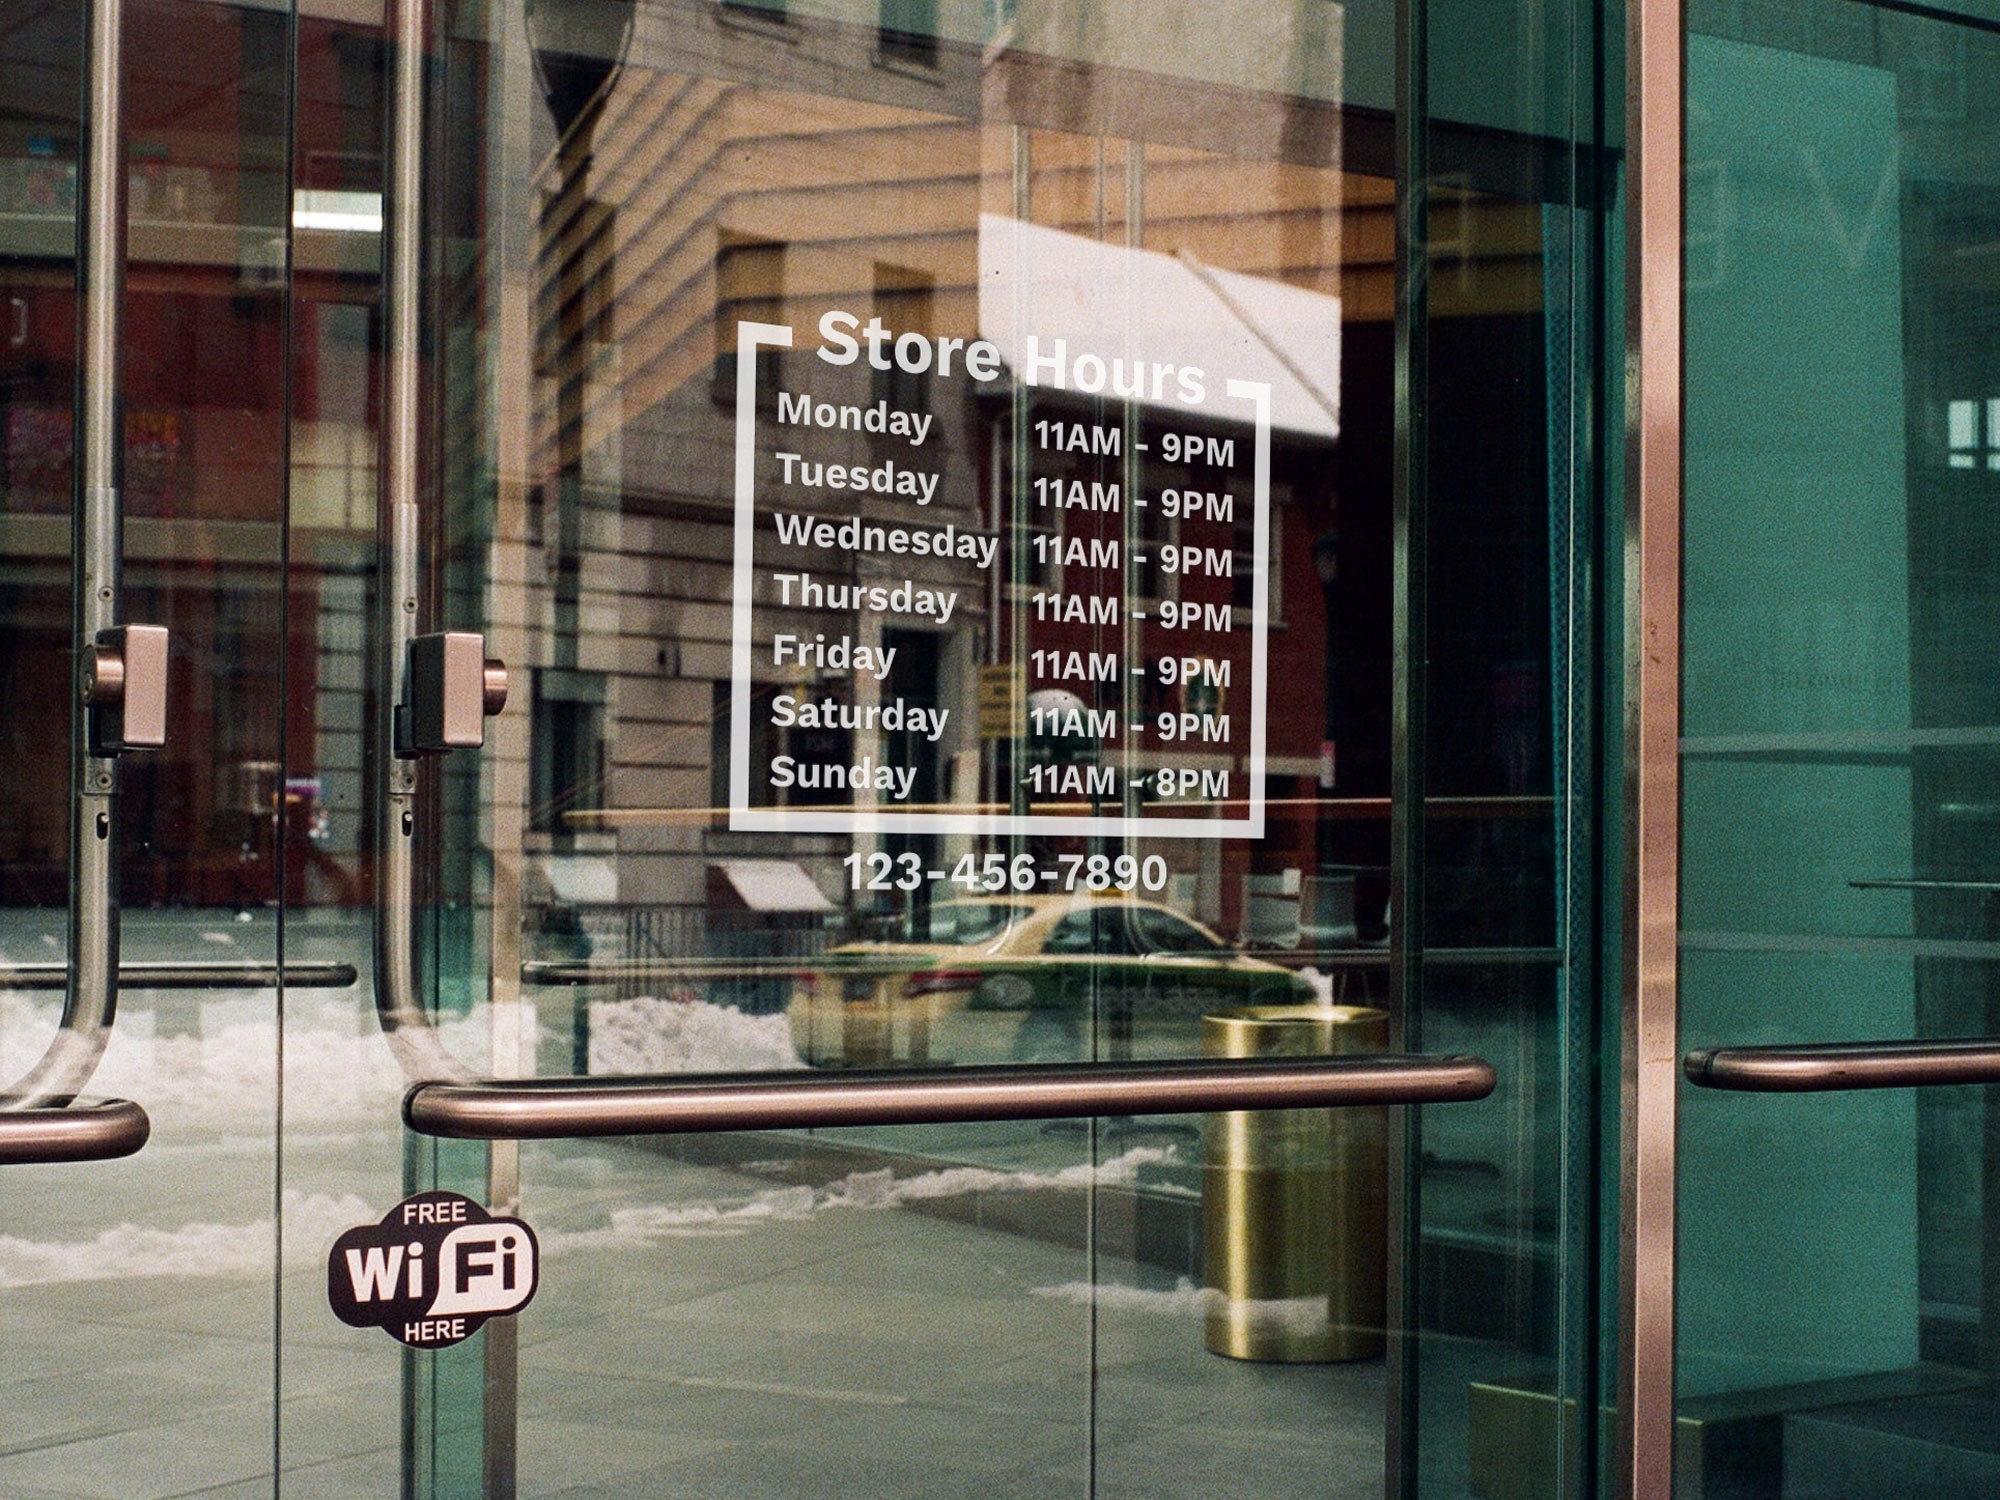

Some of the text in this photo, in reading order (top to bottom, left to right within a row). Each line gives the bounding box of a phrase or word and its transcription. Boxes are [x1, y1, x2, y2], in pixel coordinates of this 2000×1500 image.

[816, 310, 1206, 404] Store Hours
[778, 391, 1235, 468] Monday 11AM - 9PM
[775, 452, 1233, 523] Tuesday 11AM - 9PM
[773, 513, 1233, 578] Wednesday 11AM - 9PM
[773, 573, 1232, 633] Thursday 11AM - 9PM
[773, 634, 897, 680] Friday
[1030, 649, 1117, 683] 11AM
[1158, 656, 1231, 688] 9PM
[770, 695, 950, 742] Saturday
[1030, 707, 1116, 739] 11AM
[1130, 723, 1145, 731] -
[1157, 712, 1230, 743] 9PM
[769, 755, 917, 800] Sunday
[1028, 764, 1115, 796] 11AM
[1156, 767, 1229, 798] 8PM
[843, 852, 1168, 892] 123-456-7890
[403, 1201, 467, 1225] FREE
[404, 1318, 466, 1342] HERE
